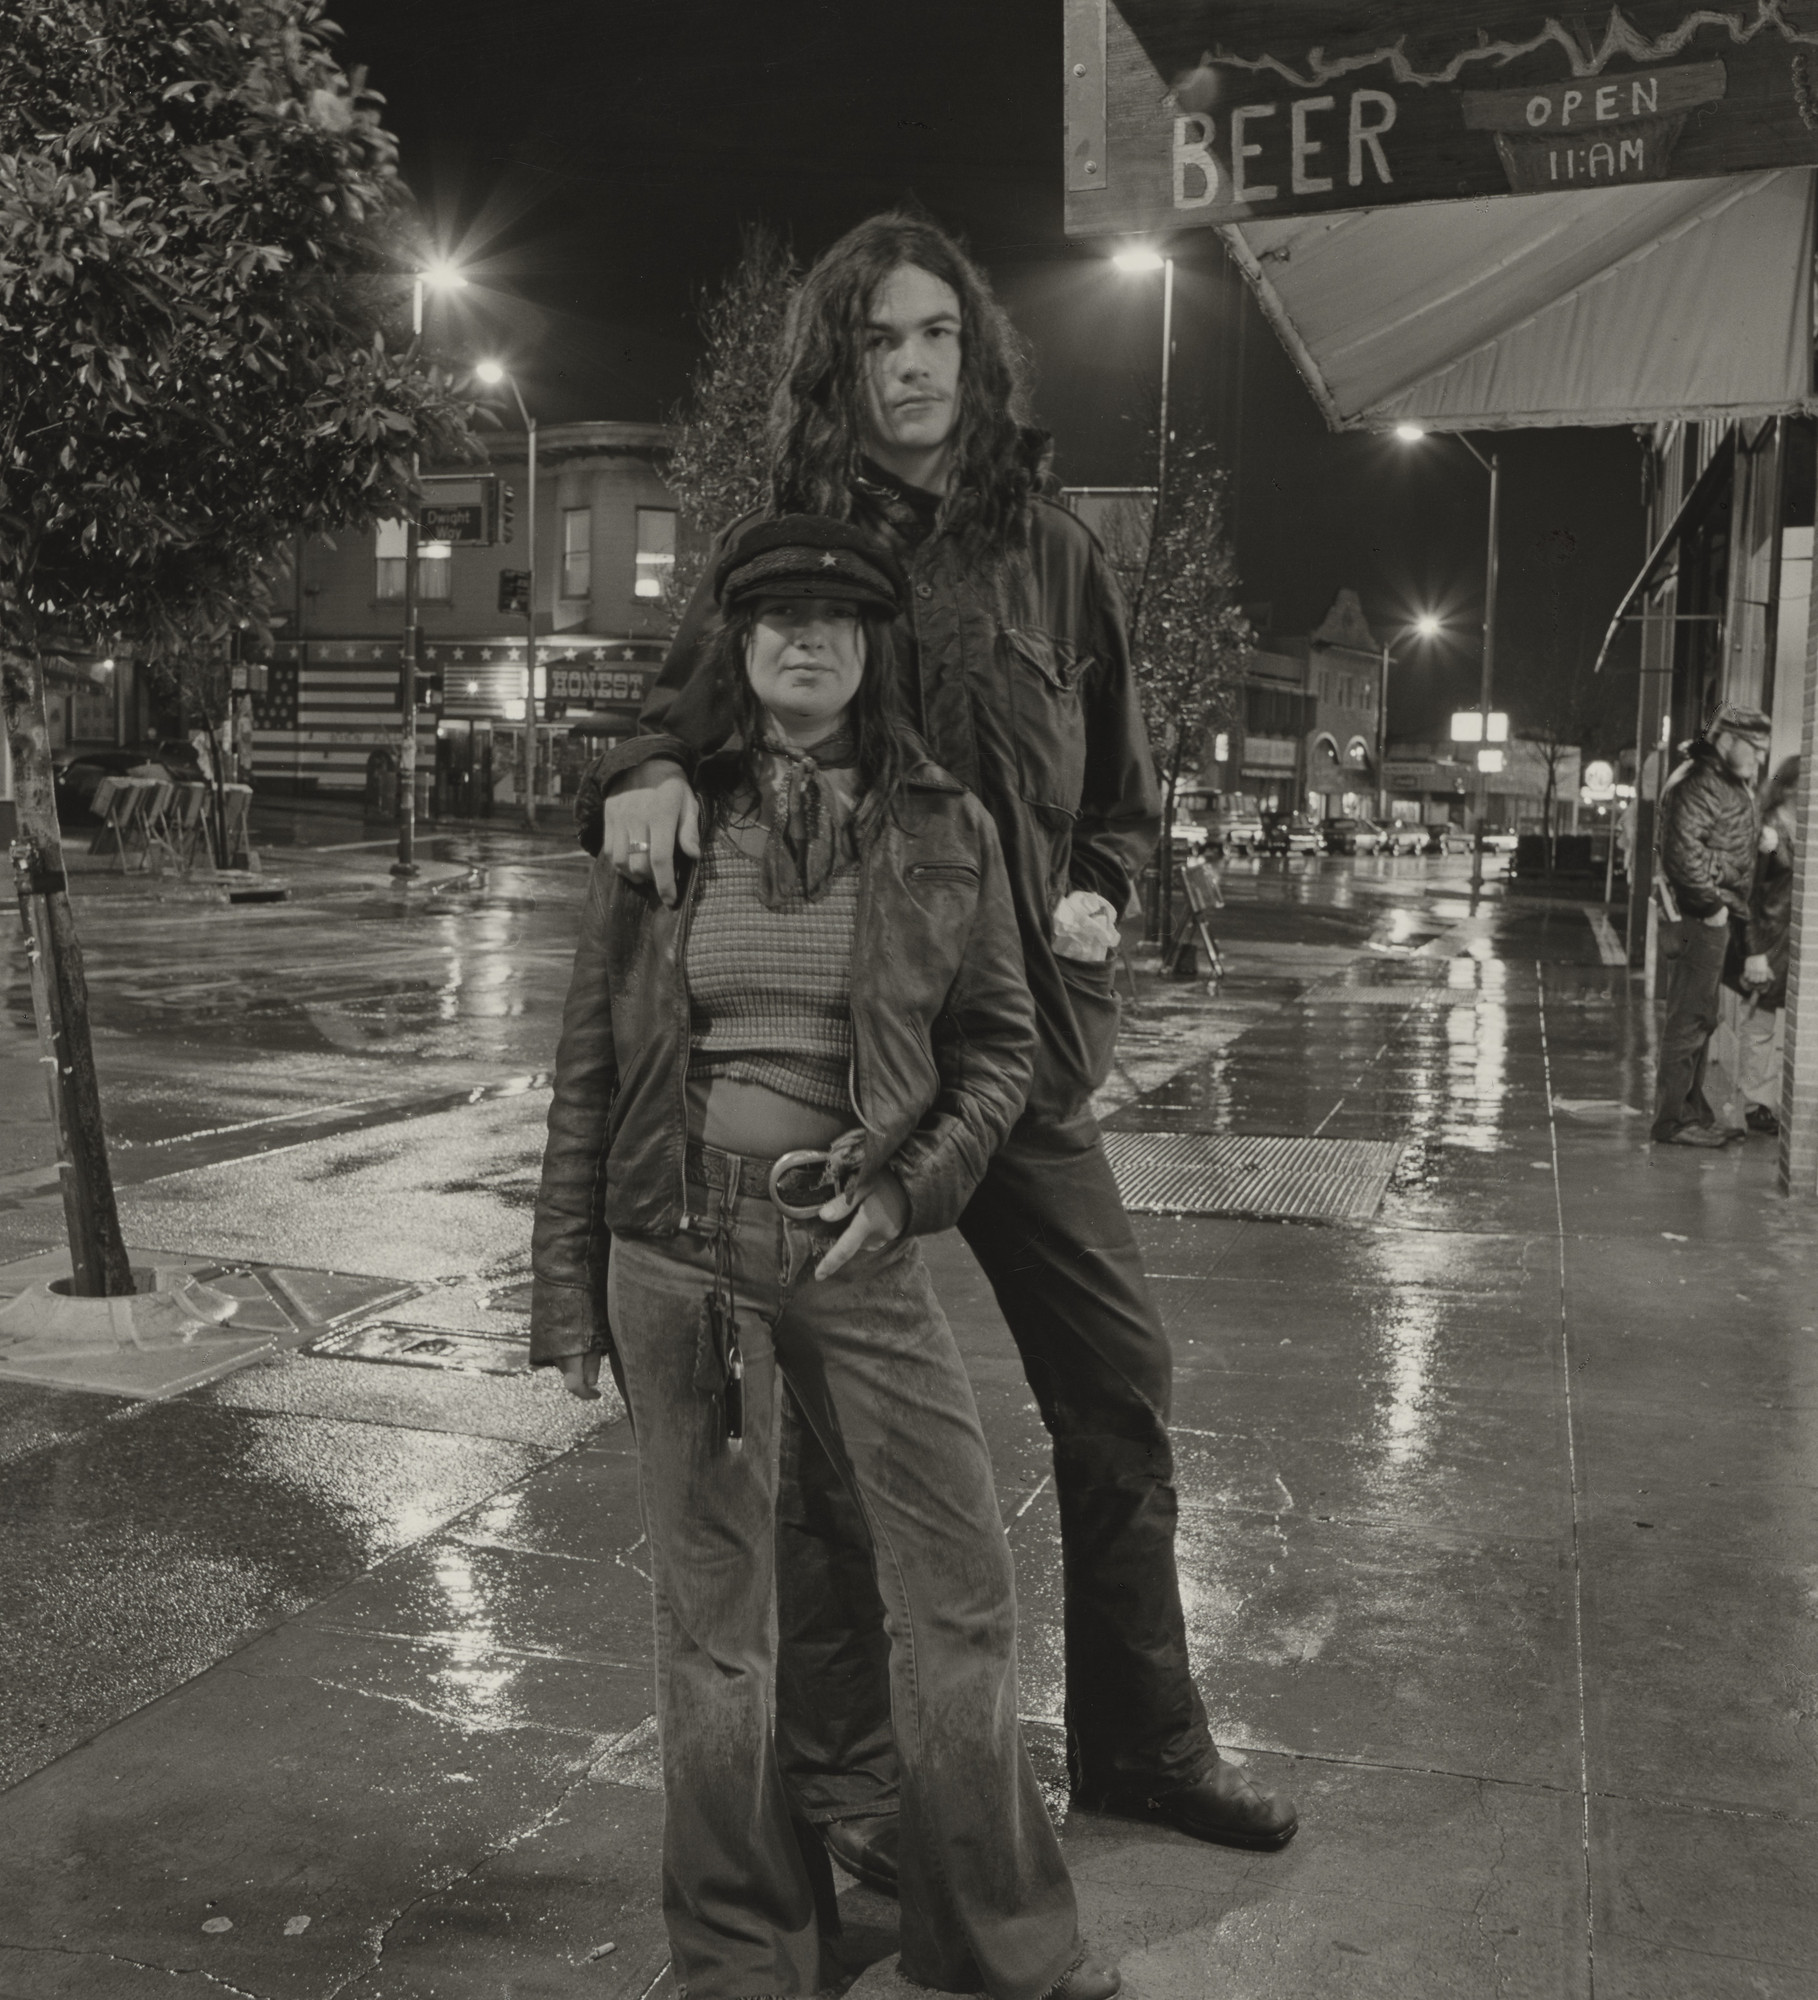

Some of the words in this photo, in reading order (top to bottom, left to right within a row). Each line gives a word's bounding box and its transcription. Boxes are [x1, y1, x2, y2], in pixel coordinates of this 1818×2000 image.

[1526, 78, 1658, 127] OPEN
[1173, 88, 1397, 209] BEER
[1550, 138, 1644, 180] 11:AM
[428, 510, 470, 526] Dwight
[436, 525, 462, 540] Way
[552, 670, 643, 699] HONEST
